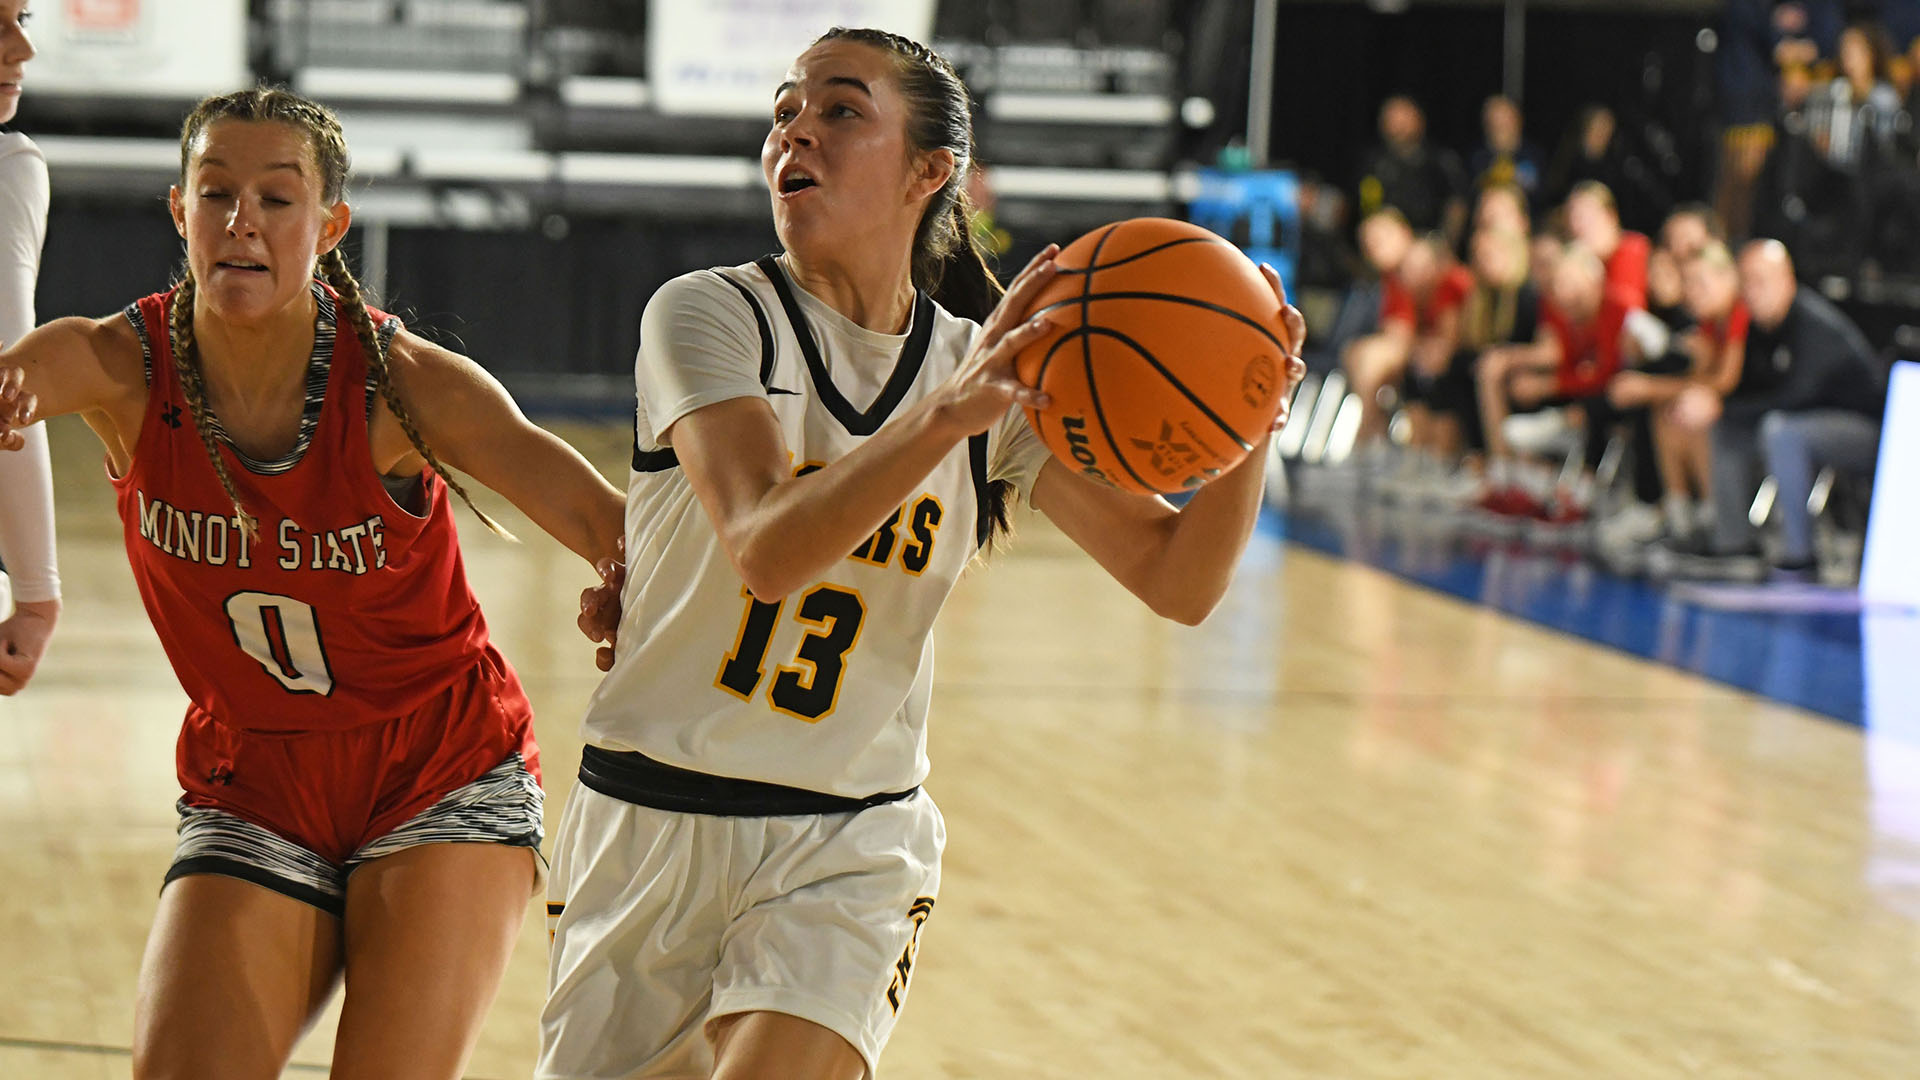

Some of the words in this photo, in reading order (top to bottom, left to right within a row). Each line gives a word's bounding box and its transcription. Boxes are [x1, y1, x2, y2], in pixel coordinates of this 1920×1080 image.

[137, 488, 259, 568] MINOT
[278, 515, 386, 576] STATE
[222, 590, 336, 698] 0
[713, 580, 868, 724] 13
